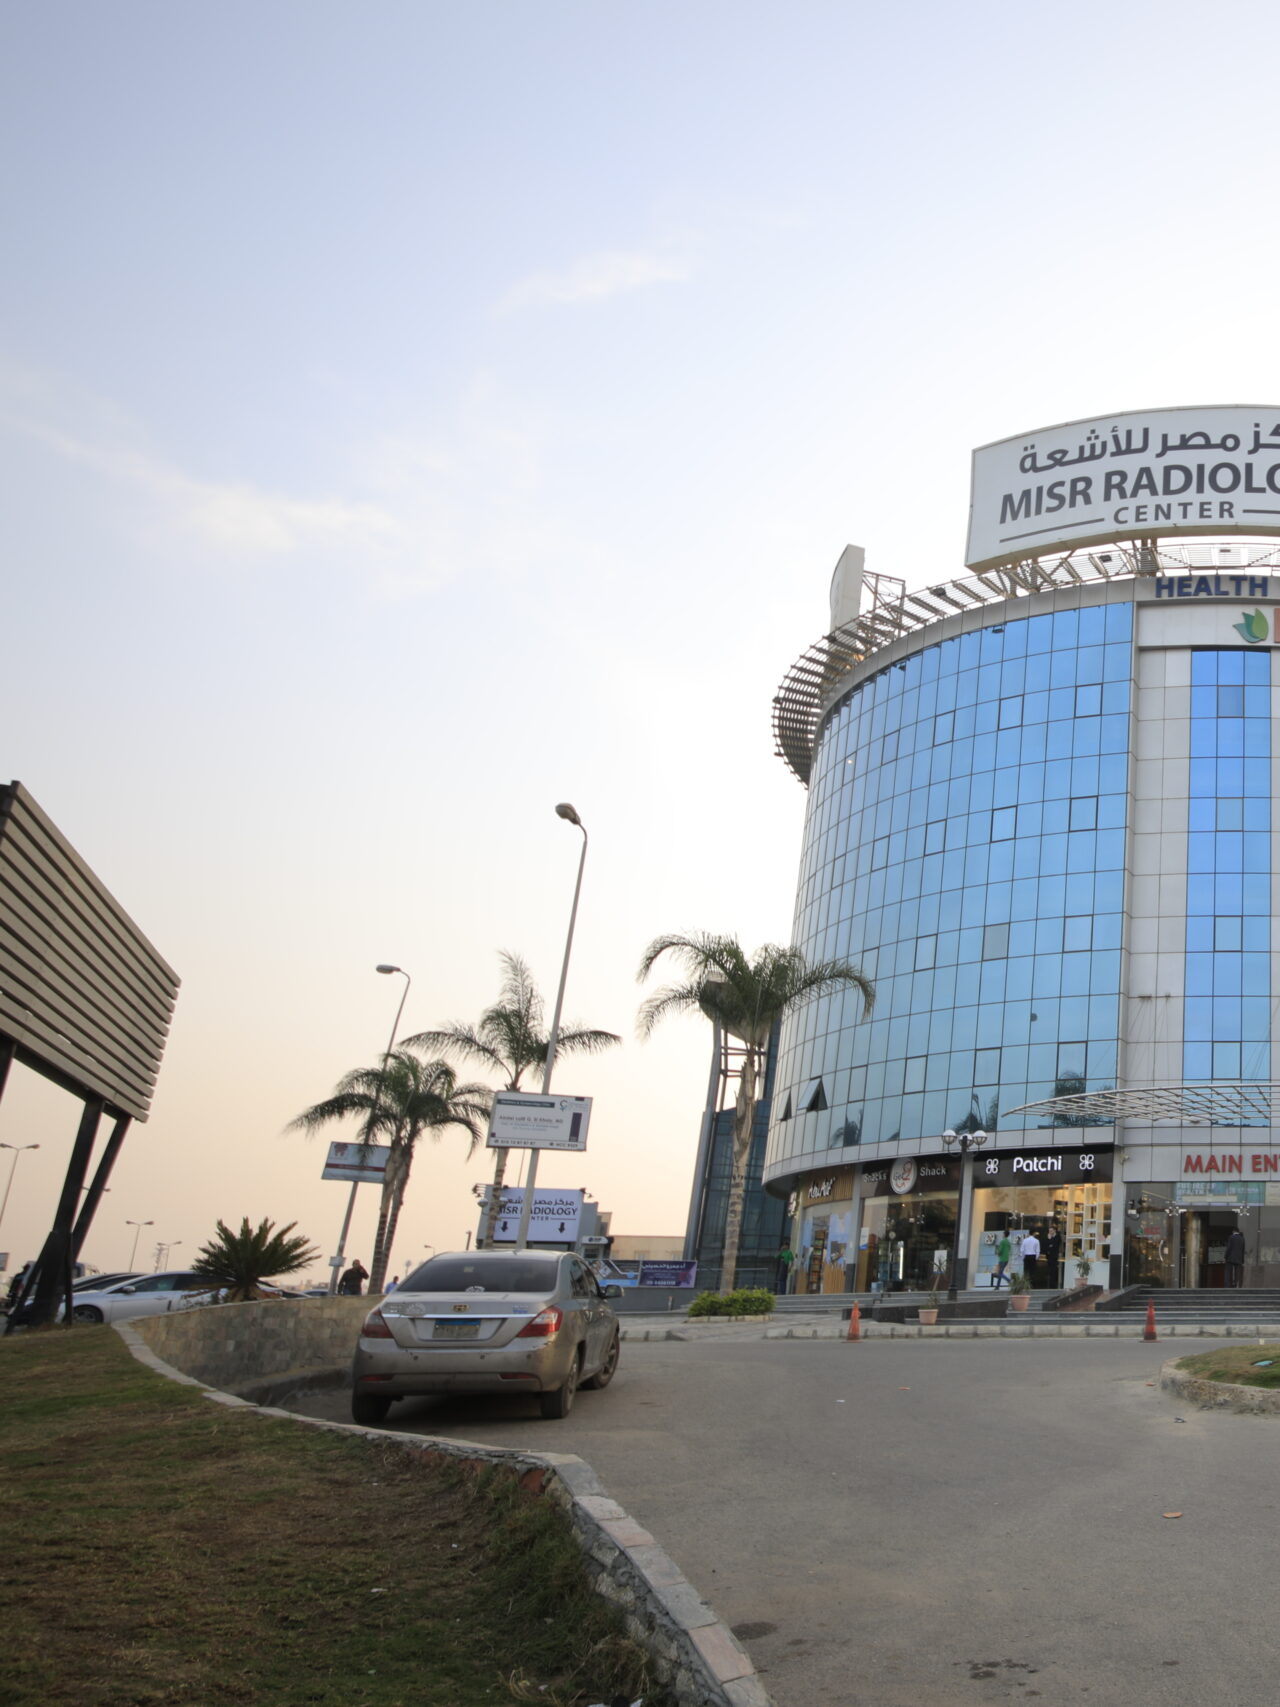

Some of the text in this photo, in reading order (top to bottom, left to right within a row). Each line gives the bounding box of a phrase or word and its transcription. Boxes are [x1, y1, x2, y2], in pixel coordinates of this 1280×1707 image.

[1019, 426, 1150, 474] للأشعة
[1155, 431, 1241, 459] مصر
[1000, 475, 1093, 524] MISR
[1114, 500, 1235, 524] CENTER
[1155, 575, 1269, 599] HEALTH
[920, 1167, 947, 1177] Shack
[1013, 1155, 1062, 1173] Patchi
[1183, 1154, 1243, 1174] MAIN
